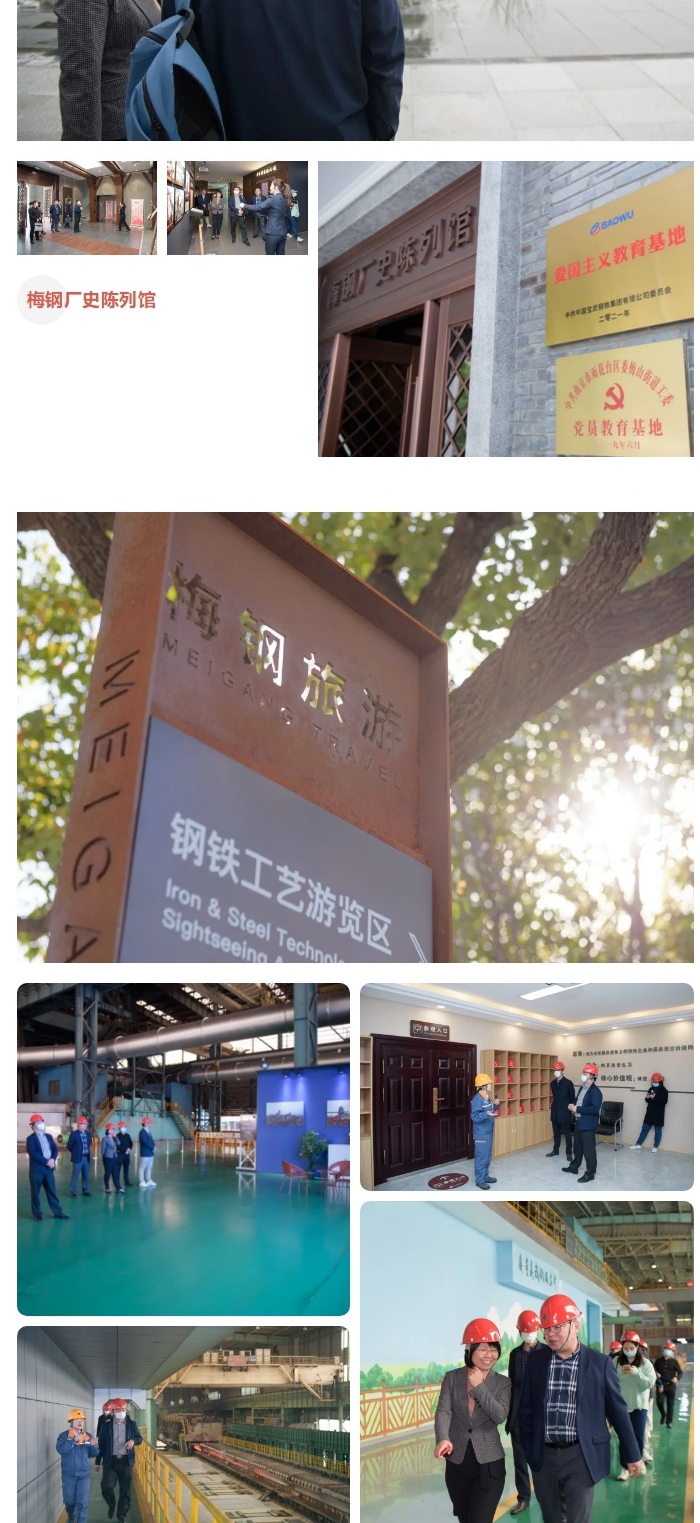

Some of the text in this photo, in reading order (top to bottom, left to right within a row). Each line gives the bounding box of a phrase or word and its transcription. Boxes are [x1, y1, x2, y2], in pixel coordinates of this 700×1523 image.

[601, 210, 634, 230] BAOWU
[554, 225, 686, 284] 爱国主义教育基地
[564, 286, 671, 318] 中共中国宝武钢铁集团有限公司委员会
[598, 309, 630, 322] 二零二一年
[573, 418, 664, 437] 党员教育基地
[165, 561, 402, 754] 梅钢旅游
[162, 632, 402, 790] MEIGANG TRAVEL
[166, 878, 202, 911] Iron
[207, 897, 221, 920] &
[227, 906, 271, 942] Steel
[170, 812, 392, 956] 钢铁工艺游览区
[162, 907, 268, 963] Sightseeing
